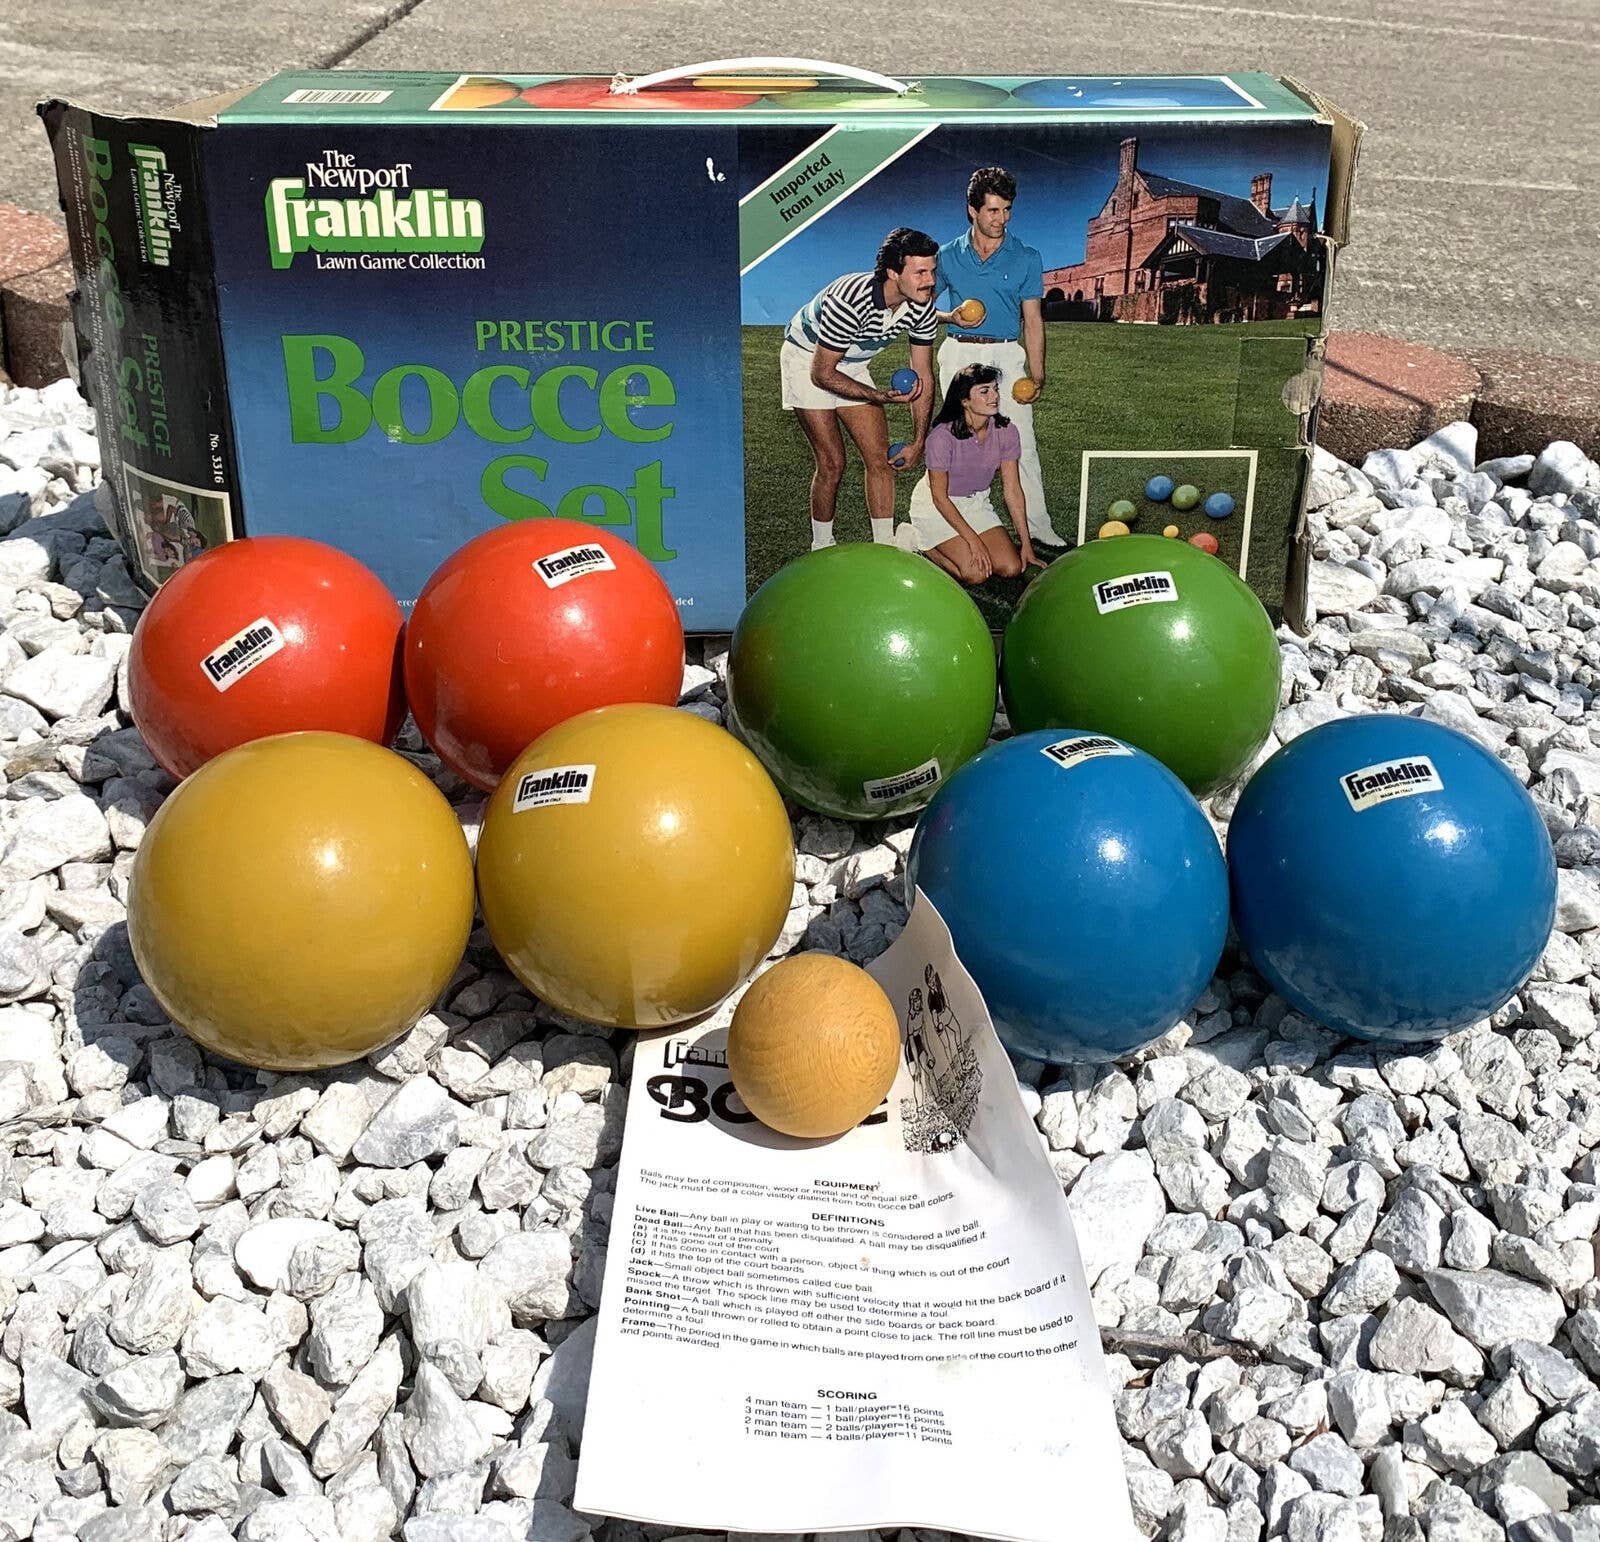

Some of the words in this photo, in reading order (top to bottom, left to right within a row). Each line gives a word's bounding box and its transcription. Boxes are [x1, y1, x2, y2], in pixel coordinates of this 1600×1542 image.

[323, 150, 356, 168] The
[129, 168, 139, 192] Lawn
[173, 183, 183, 201] The
[769, 152, 832, 205] Imported
[132, 192, 143, 219] Game
[779, 193, 814, 223] from
[812, 168, 846, 197] Italy
[81, 134, 126, 329] Bocce
[264, 177, 486, 269] Franklin
[136, 220, 148, 263] Collection
[316, 254, 357, 269] Lawn
[360, 254, 406, 269] Game
[409, 254, 486, 269] Collection
[475, 320, 655, 352] PRESTIGE
[114, 354, 149, 449] Set
[142, 333, 172, 458] PRESTIGE
[281, 333, 677, 445] Bocce
[209, 433, 220, 451] No.
[212, 455, 225, 484] 3316
[538, 548, 606, 579] Franklin
[1098, 576, 1170, 604] Franklin
[204, 626, 273, 681] Franklin
[518, 771, 588, 802] Franklin
[1345, 763, 1432, 800] Franklin
[640, 1169, 662, 1178] Balls
[766, 1191, 794, 1200] visibly
[878, 1202, 906, 1210] bocce
[909, 1201, 925, 1209] ball
[635, 1215, 660, 1224] Dead
[926, 1235, 978, 1251] disqualified
[636, 1205, 657, 1214] Live
[741, 1217, 761, 1225] play
[776, 1221, 808, 1231] waiting
[882, 1231, 934, 1240] considered
[945, 1227, 960, 1237] live
[812, 1213, 885, 1227] DEFINITIONS
[721, 1250, 756, 1258] contact
[872, 1267, 895, 1278] thing
[986, 1258, 1010, 1270] court
[771, 1264, 804, 1273] boards
[683, 1276, 709, 1284] throw
[756, 1284, 789, 1294] thrown
[793, 1288, 812, 1297] with
[816, 1291, 859, 1302] sufficient
[863, 1297, 899, 1308] velocity
[933, 1300, 963, 1309] would
[965, 1299, 977, 1307] hit
[998, 1291, 1022, 1304] back
[1024, 1282, 1051, 1297] board
[695, 1267, 724, 1275] object
[727, 1269, 744, 1277] ball
[747, 1271, 799, 1284] sometimes
[802, 1279, 831, 1287] called
[856, 1284, 872, 1292] ball
[625, 1286, 652, 1296] Bank
[723, 1302, 751, 1310] which
[765, 1307, 798, 1317] played
[816, 1313, 843, 1321] either
[865, 1318, 885, 1326] side
[889, 1321, 922, 1329] boards
[939, 1321, 963, 1329] back
[626, 1276, 662, 1287] missed
[738, 1291, 767, 1301] spock
[771, 1296, 787, 1304] line
[830, 1303, 853, 1311] used
[869, 1307, 917, 1317] determine
[623, 1307, 673, 1319] determine
[686, 1316, 703, 1324] foul
[712, 1310, 745, 1320] thrown
[760, 1317, 788, 1327] rolled
[803, 1323, 832, 1332] obtain
[845, 1327, 868, 1337] point
[872, 1331, 898, 1340] close
[940, 1332, 957, 1341] The
[960, 1331, 975, 1339] roll
[978, 1330, 995, 1338] line
[998, 1328, 1023, 1337] must
[1039, 1319, 1062, 1332] used
[621, 1327, 640, 1335] and
[643, 1330, 673, 1340] points
[676, 1335, 720, 1348] awarded
[689, 1326, 720, 1339] period
[750, 1337, 778, 1347] game
[792, 1342, 820, 1353] which
[822, 1346, 845, 1355] balls
[866, 1352, 899, 1361] played
[998, 1351, 1023, 1360] court
[1053, 1339, 1078, 1353] other
[755, 1398, 778, 1406] man
[781, 1401, 807, 1410] team
[913, 1407, 944, 1417] points
[817, 1390, 877, 1399] SCORING
[745, 1416, 752, 1424] 2
[754, 1419, 778, 1427] man
[781, 1421, 807, 1429] team
[921, 1426, 952, 1436] points
[755, 1408, 778, 1416] man
[781, 1411, 807, 1420] team
[914, 1417, 945, 1426] points
[754, 1429, 778, 1437] man
[781, 1431, 807, 1439] team
[922, 1434, 952, 1445] points
